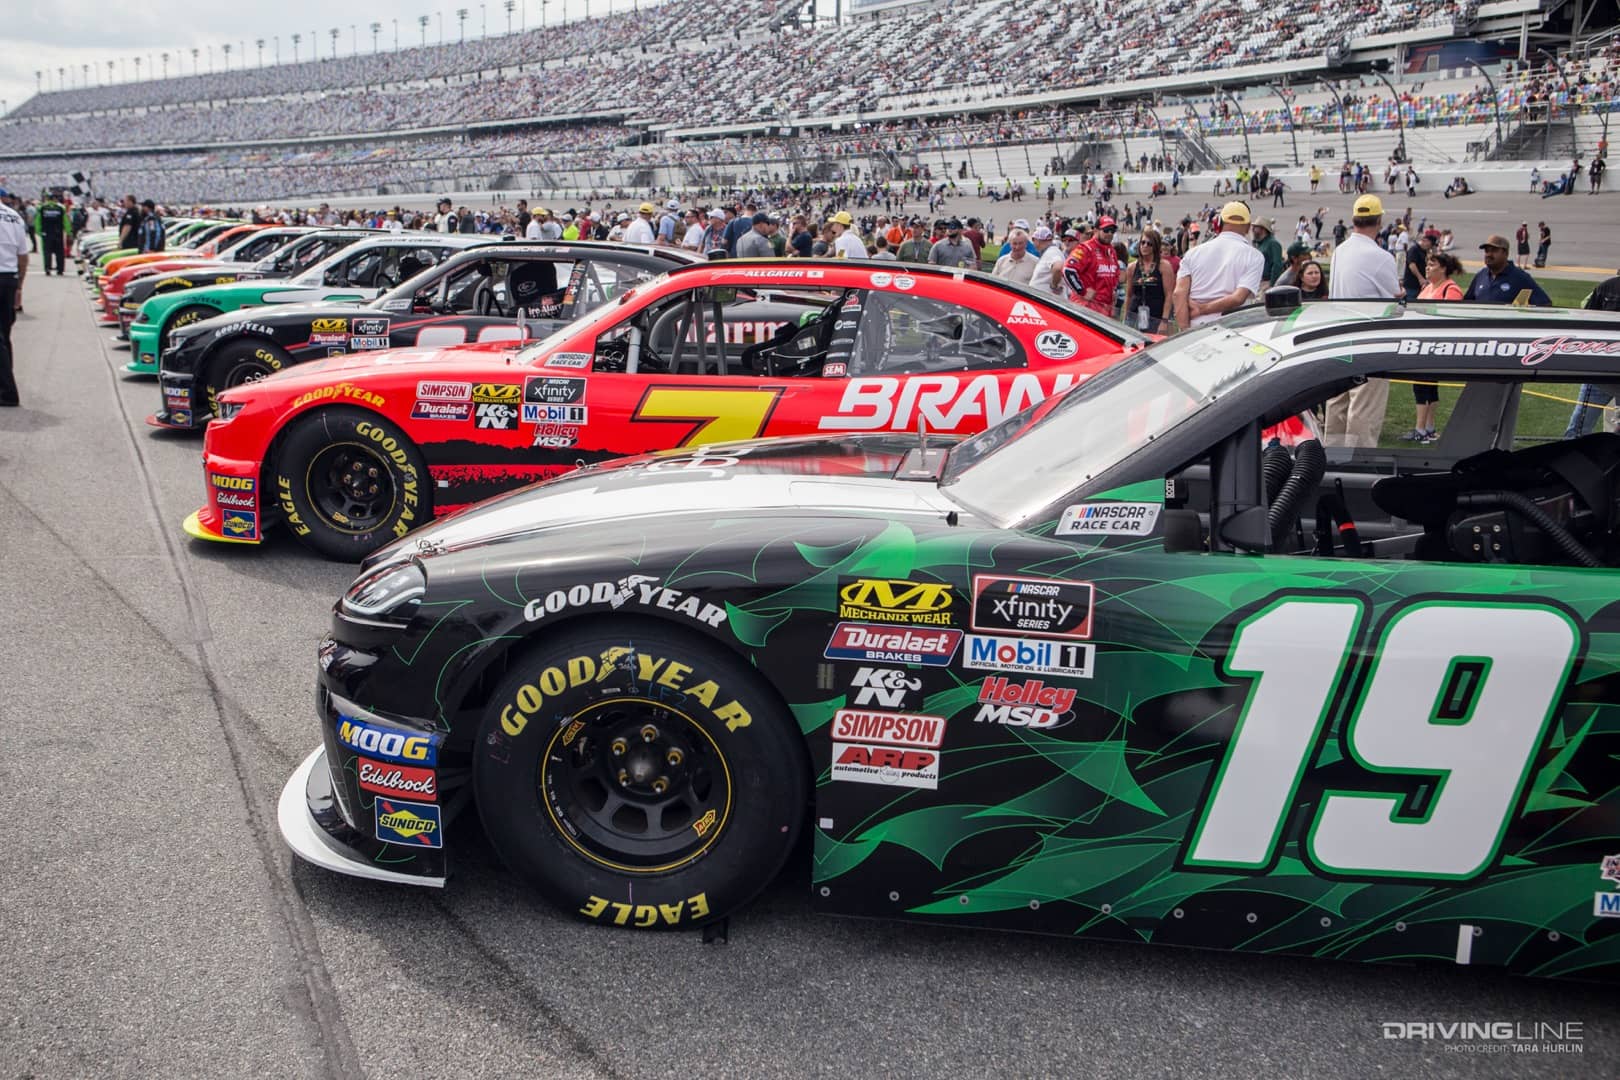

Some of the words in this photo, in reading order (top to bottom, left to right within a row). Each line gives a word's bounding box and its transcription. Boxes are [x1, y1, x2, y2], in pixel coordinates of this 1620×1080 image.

[215, 320, 274, 338] GOODYEAR
[358, 323, 384, 333] xfinity
[1007, 316, 1048, 326] AXALTA
[1398, 339, 1536, 357] Brandon
[255, 349, 283, 369] GOO
[825, 365, 844, 375] SEM
[292, 383, 386, 408] GOODYEAR
[420, 384, 467, 397] SIMPSON
[534, 384, 576, 400] xfinity
[418, 402, 468, 414] Duralast
[818, 374, 1094, 430] BRAN
[524, 405, 566, 420] Mobil
[631, 389, 777, 448] 7
[534, 423, 578, 440] Holley
[533, 436, 572, 447] MSD
[211, 474, 254, 490] MOOG
[355, 421, 419, 537] GOODYEAR
[217, 492, 255, 507] Edelbrock
[278, 475, 312, 536] EAGLE
[1091, 506, 1147, 518] NASCAR
[224, 520, 254, 529] SUNOCO
[1070, 521, 1107, 530] RACE
[1111, 521, 1141, 531] CAR
[1020, 584, 1060, 596] NASCAR
[523, 577, 729, 629] GOODYEAR
[992, 595, 1073, 626] xfinity
[840, 605, 909, 622] MECHANIX
[912, 612, 951, 625] WEAR
[1016, 618, 1051, 630] SERIES
[843, 627, 950, 653] Duralast
[866, 650, 922, 662] BRAKES
[971, 637, 1052, 666] Mobil
[970, 661, 998, 669] OFFICIAL
[1000, 663, 1024, 671] MOTOR
[1043, 667, 1085, 676] LUBRICANTS
[500, 648, 753, 736] GOODYEAR
[978, 676, 1078, 715] Holley
[974, 704, 1060, 728] MSD
[838, 713, 938, 743] SIMPSON
[340, 720, 430, 760] MOOG
[1187, 598, 1579, 878] 19
[836, 746, 936, 771] ARP
[359, 763, 435, 794] Edelbrock
[834, 766, 880, 775] automotive
[901, 771, 937, 780] products
[381, 814, 434, 832] SUNOCO
[579, 892, 712, 927] EAGLE
